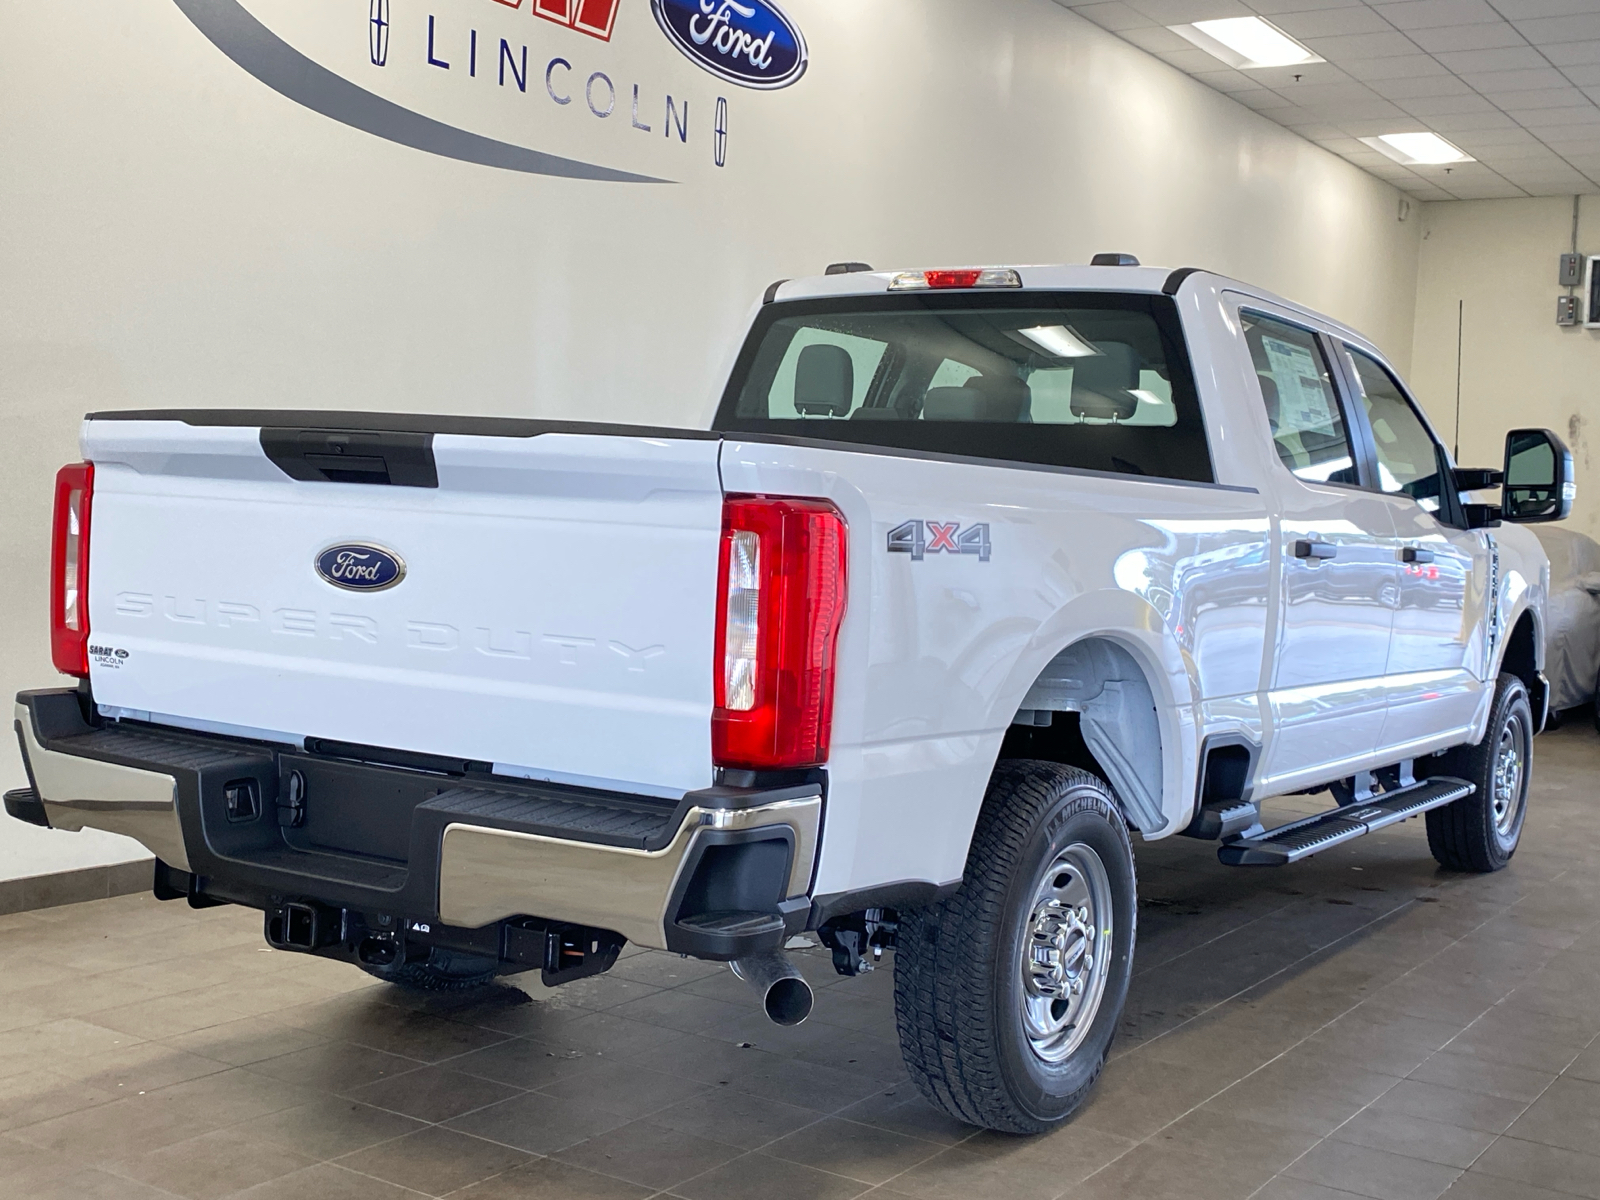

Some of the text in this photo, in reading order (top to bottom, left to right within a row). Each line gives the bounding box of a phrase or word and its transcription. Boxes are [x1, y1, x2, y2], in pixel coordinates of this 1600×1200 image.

[689, 0, 776, 70] Ford
[427, 14, 688, 143] LINCOLN
[331, 551, 382, 581] Ford
[115, 591, 665, 672] SUPER DUTY
[95, 655, 124, 665] LINCOLN
[1062, 797, 1107, 821] MICHELIN
